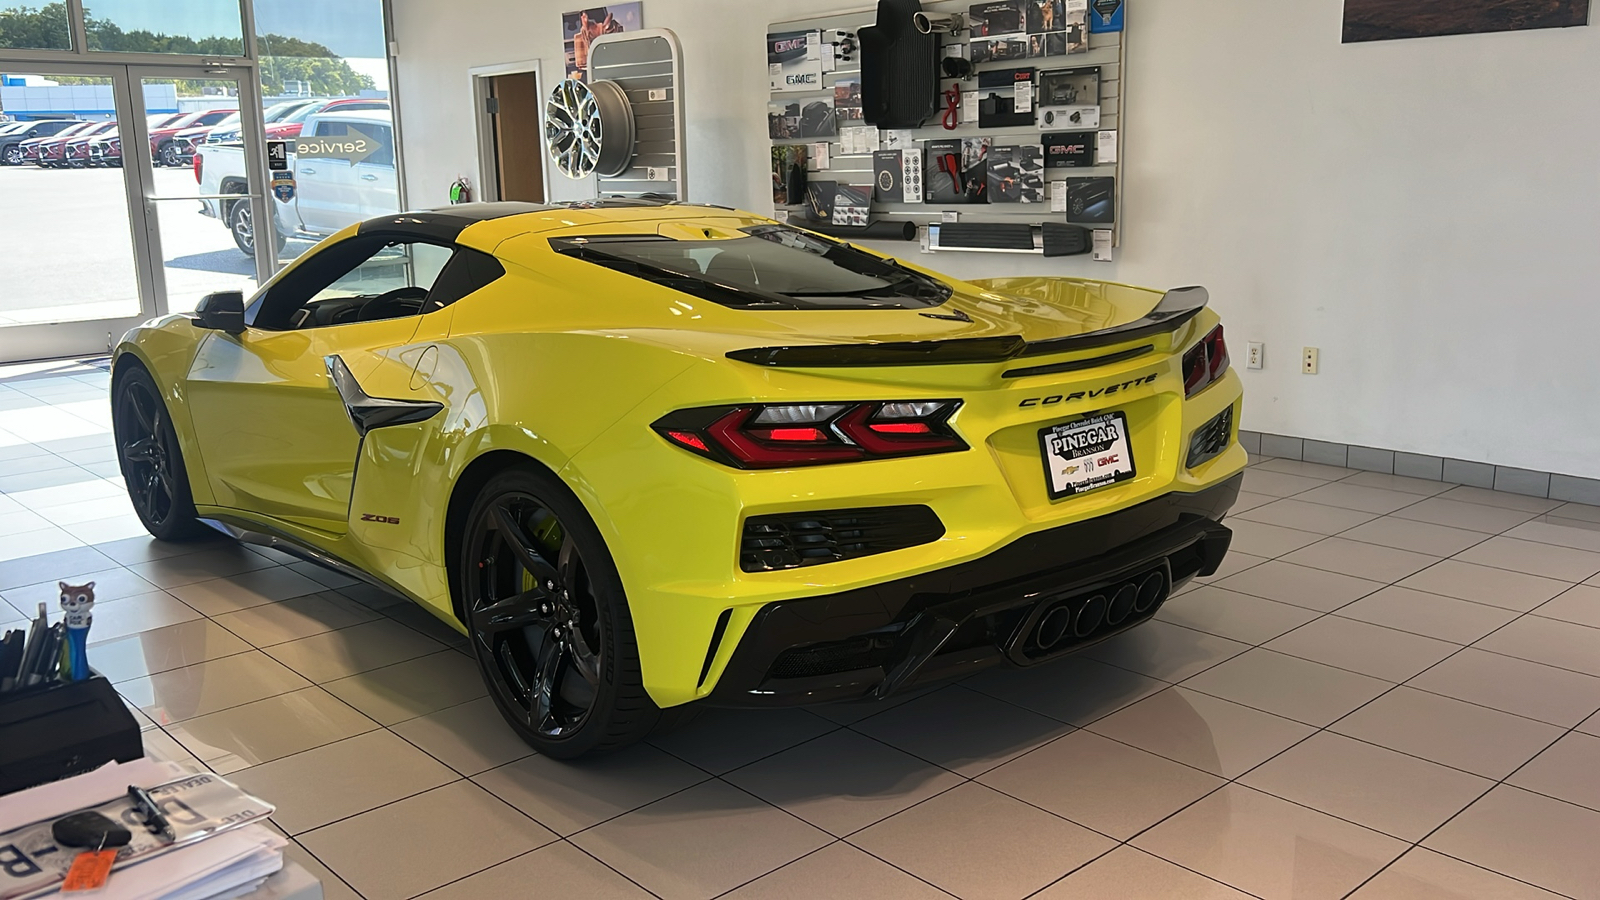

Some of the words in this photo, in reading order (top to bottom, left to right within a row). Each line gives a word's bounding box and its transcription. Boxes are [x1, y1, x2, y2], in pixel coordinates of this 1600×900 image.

[775, 37, 806, 53] GMC
[785, 72, 817, 85] GMC
[1049, 144, 1085, 155] GMC
[1018, 372, 1158, 407] CORVETTE
[1052, 425, 1070, 433] Pinegar
[1069, 418, 1091, 430] Chevrolet
[1091, 416, 1104, 425] Buick
[1103, 412, 1115, 421] GMC
[1051, 425, 1119, 455] PINEGAR
[1097, 454, 1119, 467] GMC
[1075, 478, 1116, 493] PinegarBranson.com
[360, 513, 400, 525] Z06
[220, 809, 256, 825] DEC
